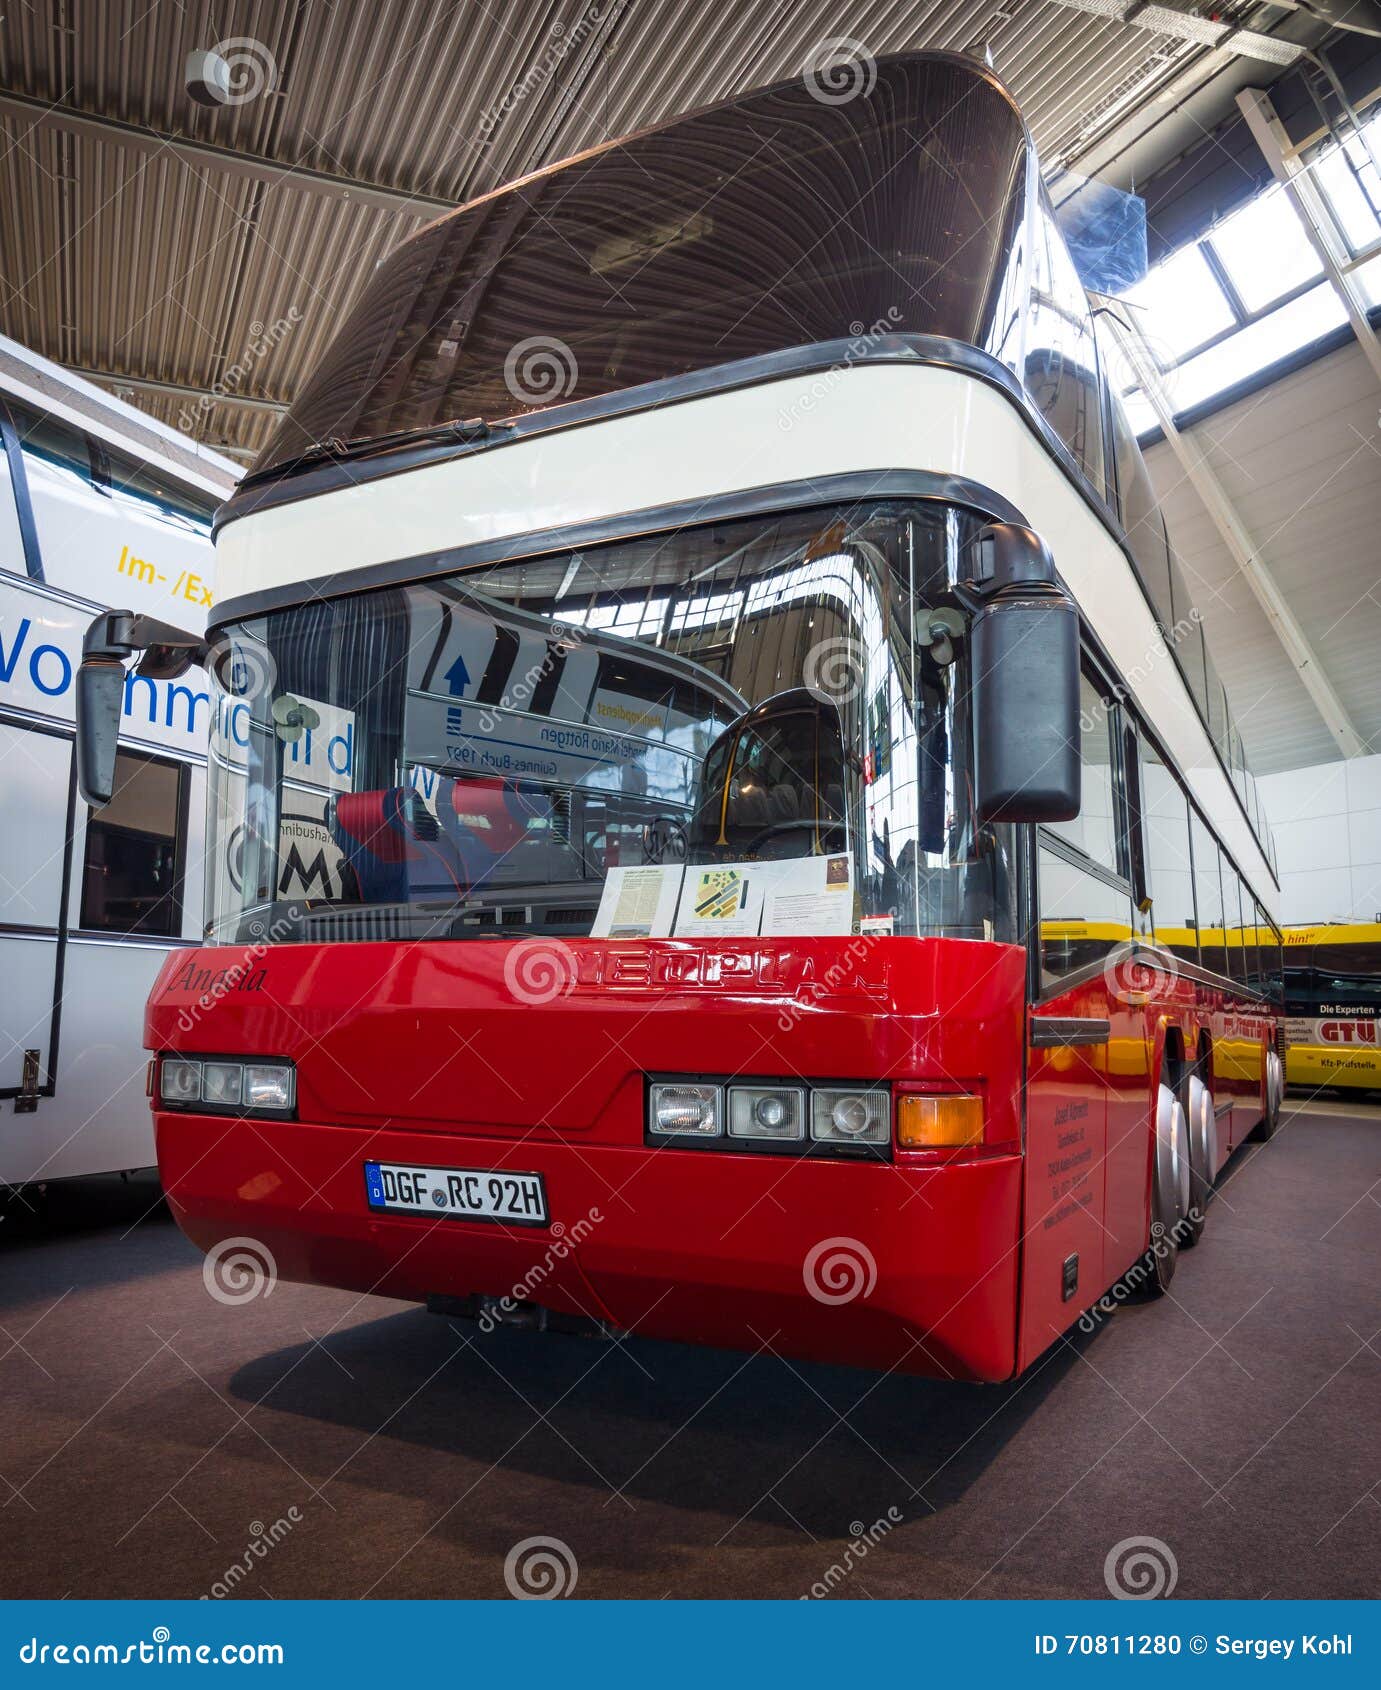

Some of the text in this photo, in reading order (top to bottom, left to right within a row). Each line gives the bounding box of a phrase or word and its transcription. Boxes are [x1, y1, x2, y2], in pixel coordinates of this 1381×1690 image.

[1319, 1004, 1375, 1017] Die Experten
[1320, 1018, 1377, 1043] GTÜ
[381, 1169, 542, 1215] DGF RC 92H
